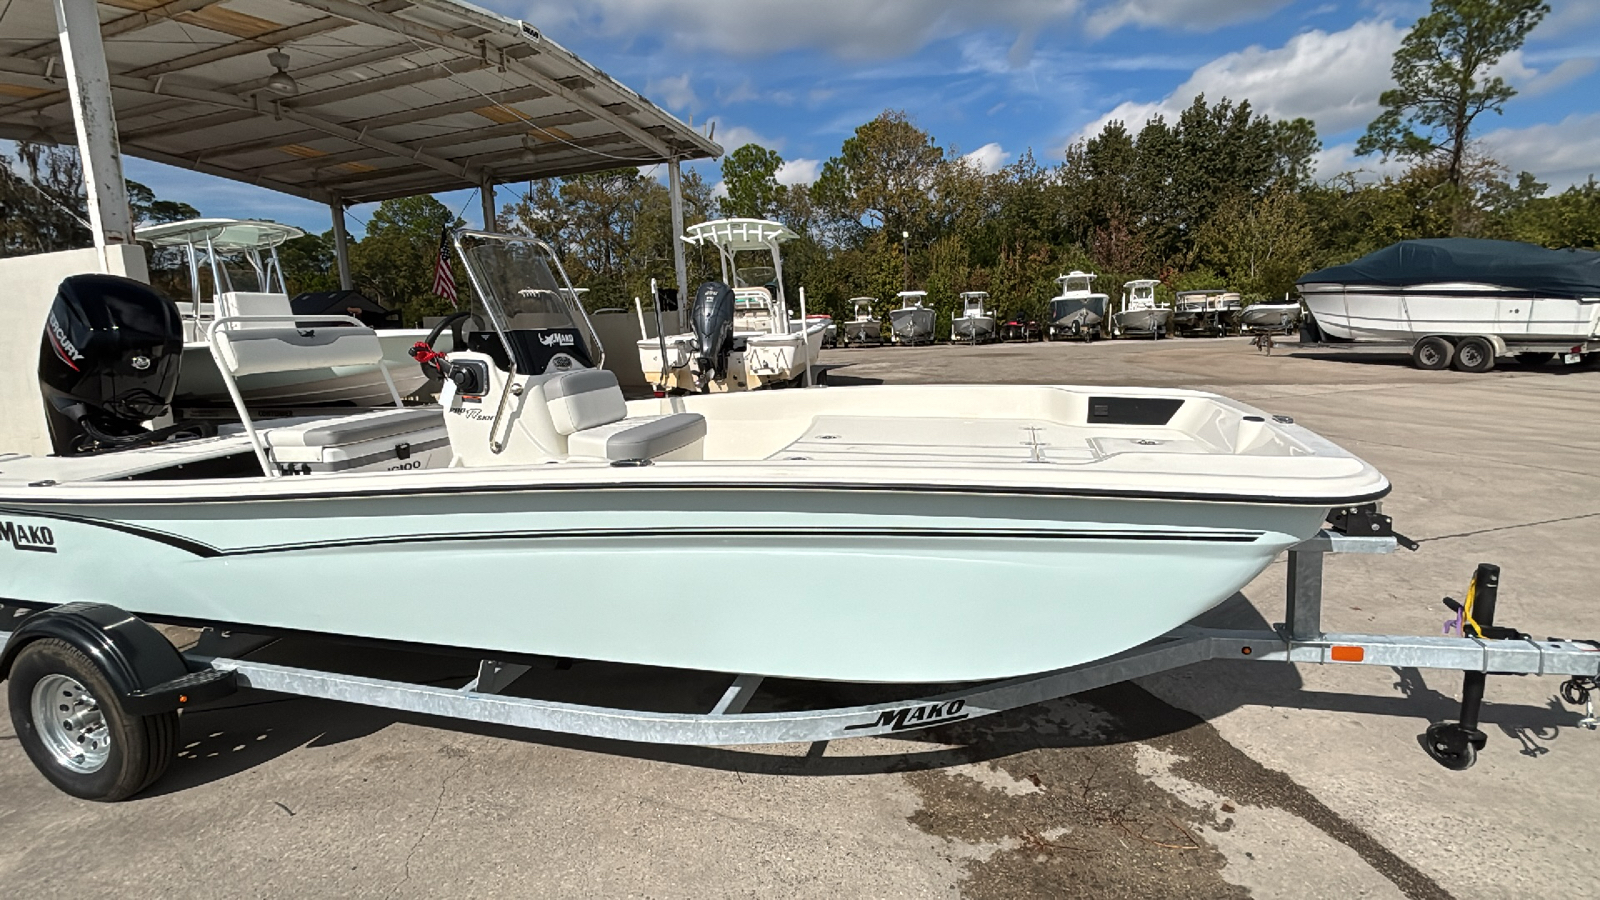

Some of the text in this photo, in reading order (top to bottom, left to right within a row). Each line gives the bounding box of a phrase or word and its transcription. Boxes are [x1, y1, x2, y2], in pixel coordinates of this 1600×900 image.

[49, 310, 85, 361] ERCURY
[552, 332, 575, 346] MAKO
[0, 521, 57, 553] MAKO
[845, 699, 969, 731] MAKO
